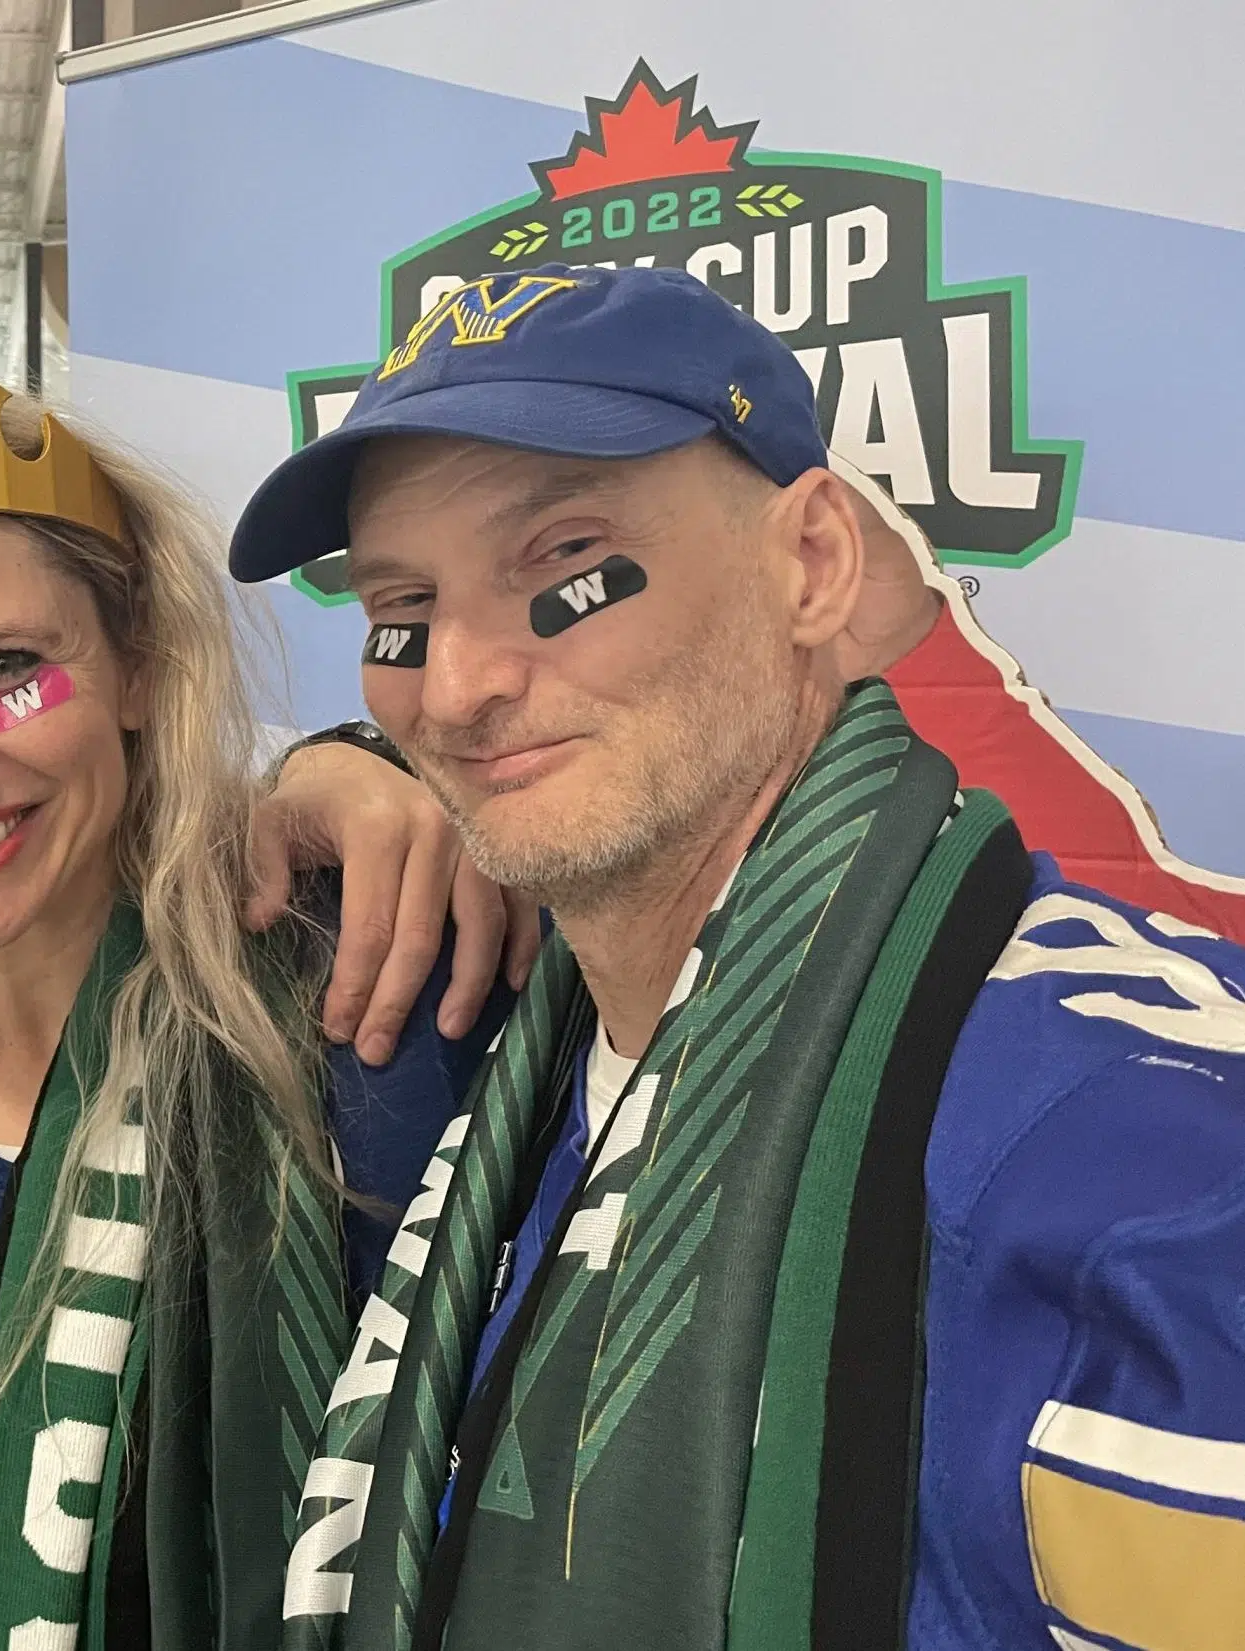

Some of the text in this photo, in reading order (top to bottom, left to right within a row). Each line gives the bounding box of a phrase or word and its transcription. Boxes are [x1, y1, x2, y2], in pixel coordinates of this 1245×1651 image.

[561, 186, 722, 249] 2022
[558, 570, 607, 616] W
[375, 627, 412, 661] W
[0, 679, 45, 720] W
